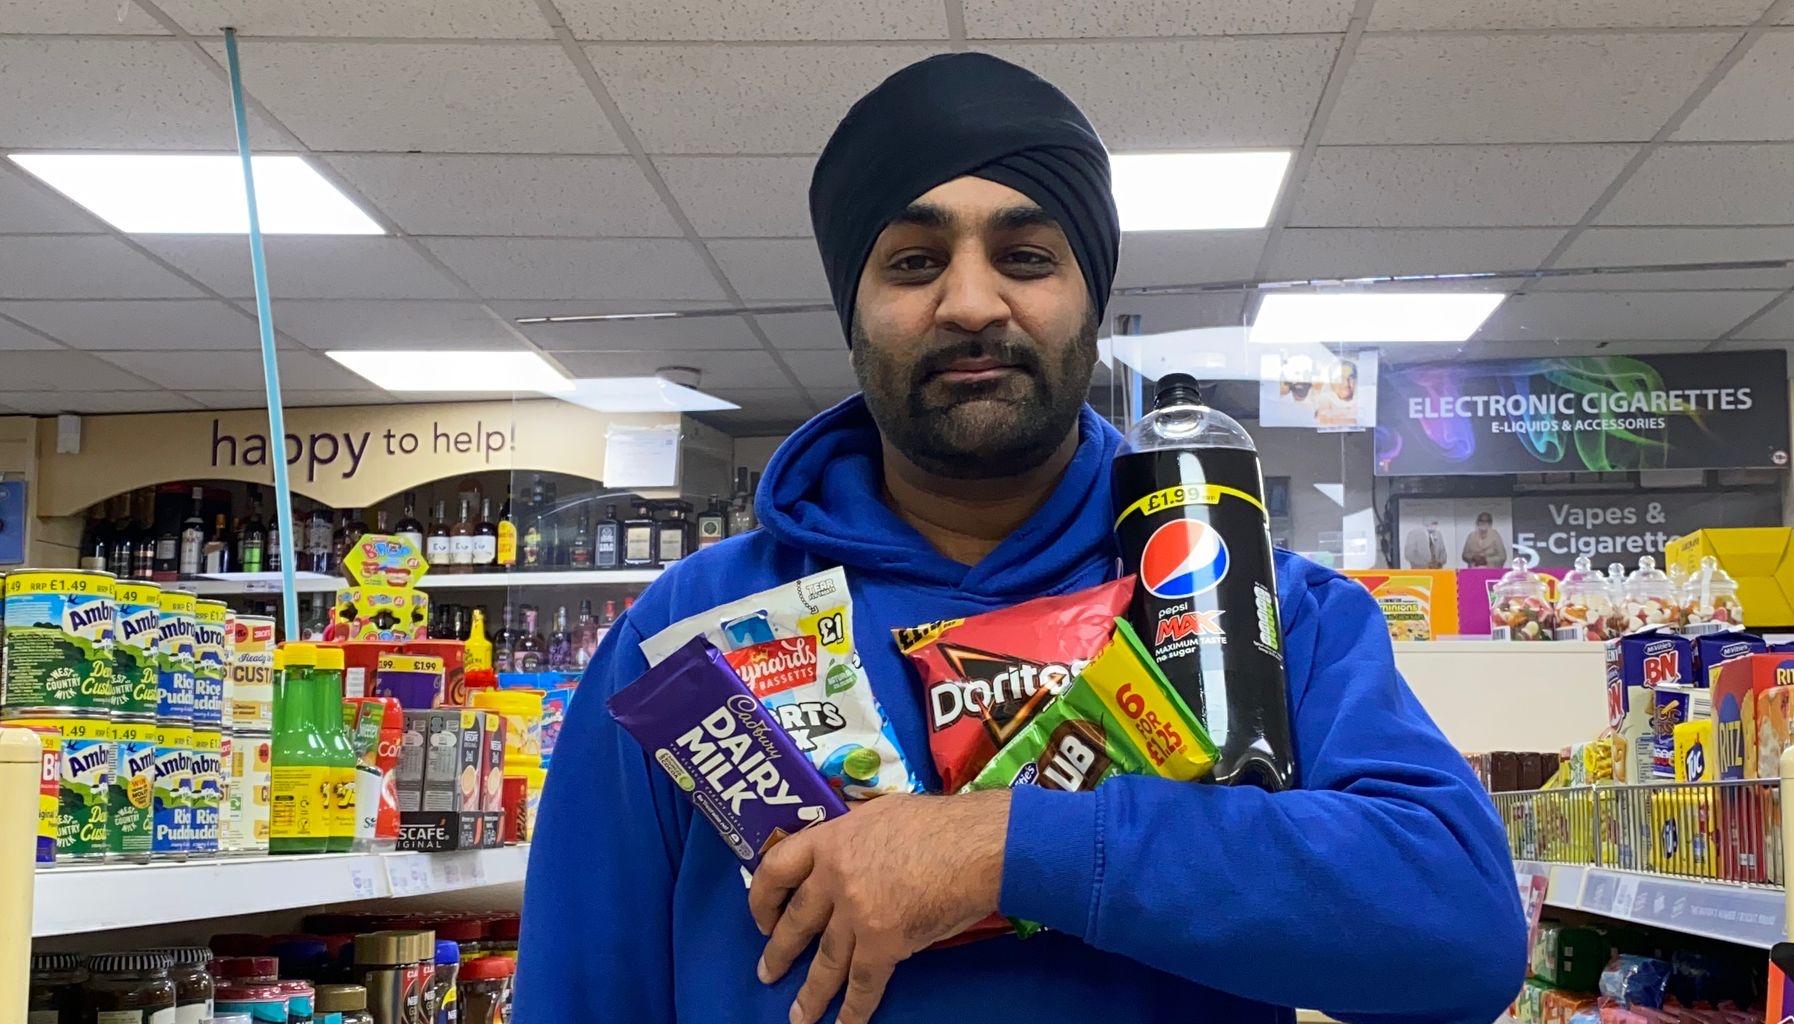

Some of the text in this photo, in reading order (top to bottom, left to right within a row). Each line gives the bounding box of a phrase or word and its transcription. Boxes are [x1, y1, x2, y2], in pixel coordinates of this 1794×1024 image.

[1408, 387, 1753, 419] ELECTRONIC CIGARETTES
[1491, 416, 1666, 434] E-LIQUIDS & ACCESSORIES
[211, 419, 516, 482] happy to help!
[1148, 487, 1200, 512] £1.99
[1548, 501, 1667, 530] Vapes &
[50, 579, 87, 592] £1.49
[1158, 601, 1189, 619] pepsi
[1155, 609, 1227, 646] MAX
[1155, 636, 1228, 657] MAXIMUM TASTE
[1156, 645, 1197, 663] no sugar
[413, 661, 437, 671] £1.99
[736, 639, 817, 691] ynards
[758, 667, 815, 691] BASSETTS
[1643, 651, 1681, 687] BN
[46, 677, 80, 691] COUNTRY
[1115, 682, 1145, 719] 6
[726, 694, 782, 761] Cadbury
[1136, 710, 1162, 739] FOR
[701, 706, 803, 806] DAIRY
[1145, 721, 1183, 767] £1.25
[1718, 720, 1744, 773] RITZ
[676, 725, 759, 817] MILK
[1042, 735, 1096, 793] UB
